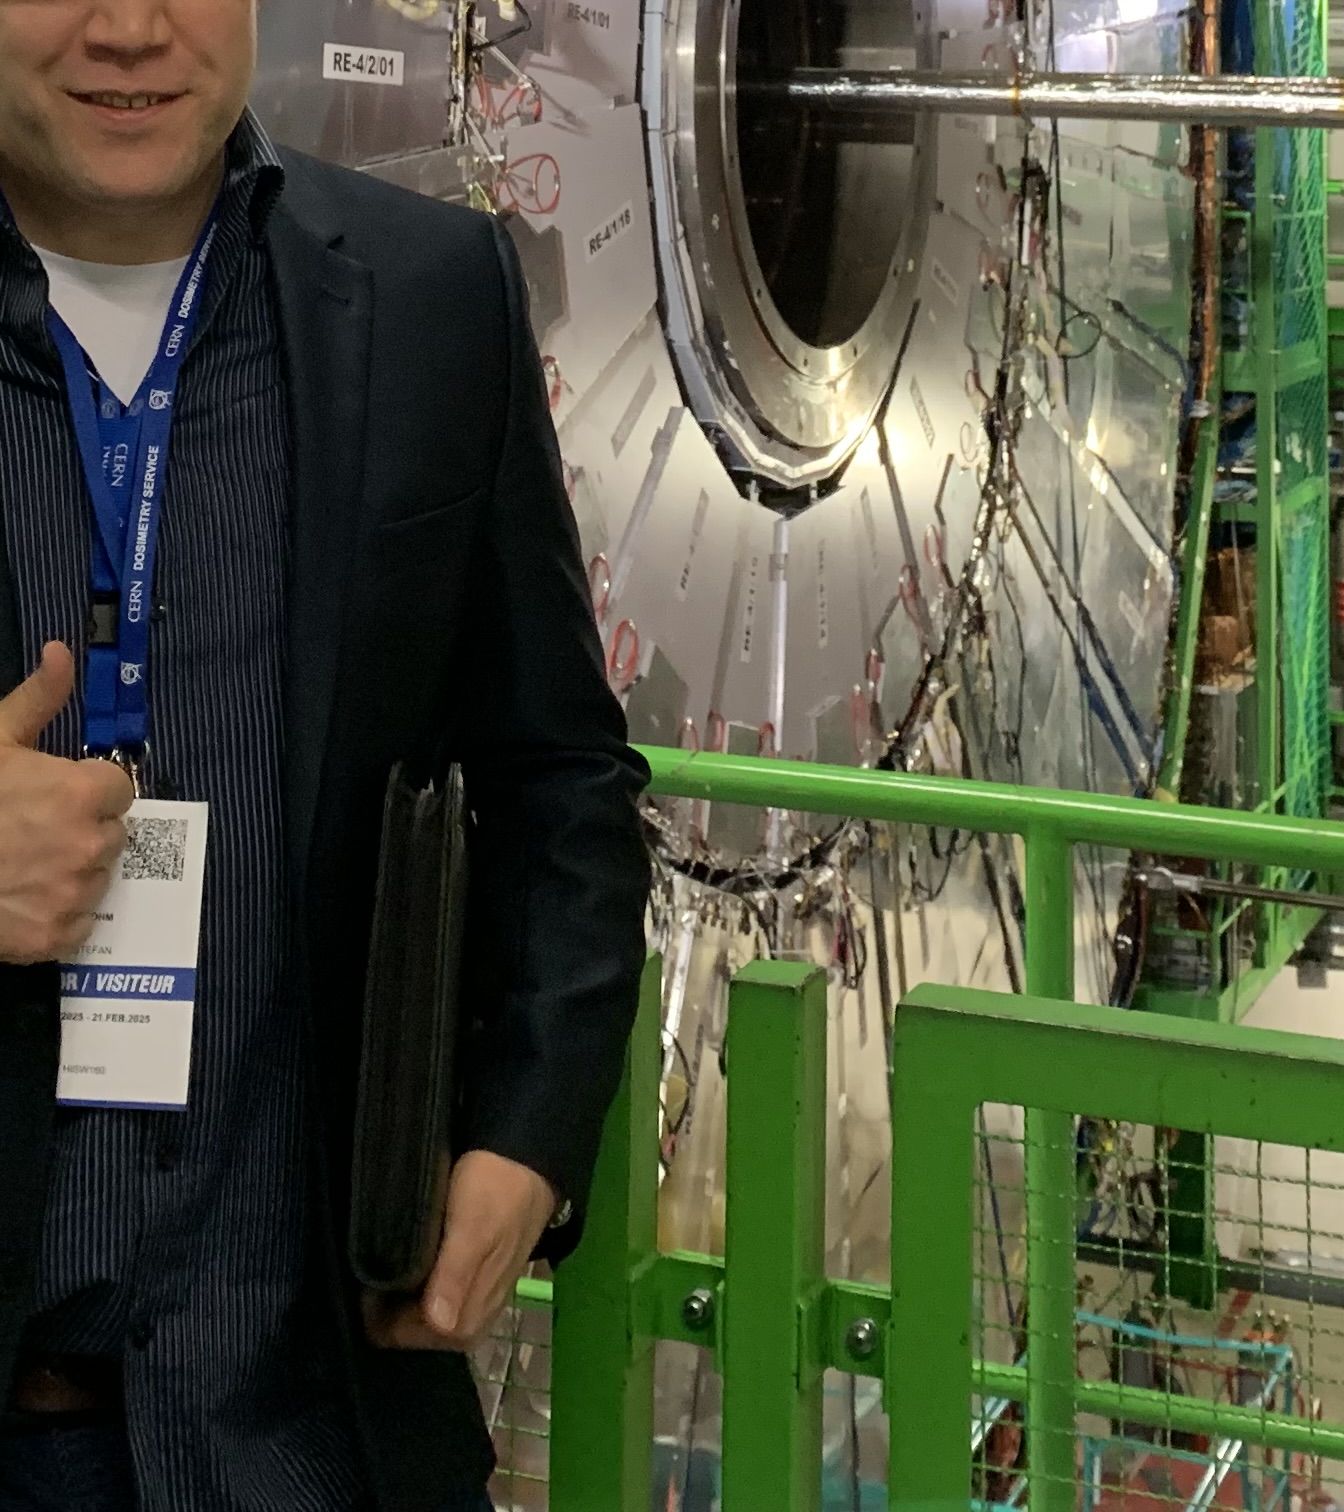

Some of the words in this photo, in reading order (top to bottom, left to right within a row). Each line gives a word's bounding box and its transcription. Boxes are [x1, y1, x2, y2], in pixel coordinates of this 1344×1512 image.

[566, 1, 610, 29] RE-4/1/01
[333, 52, 394, 77] RE-4/2/01
[588, 208, 631, 256] RE-4/1/18
[164, 324, 186, 357] CERN
[177, 261, 204, 319] DOSIMETRY
[111, 443, 129, 487] CERN
[143, 445, 160, 499] SERVICE
[133, 499, 152, 571] DOSIMETRY
[127, 580, 143, 623] CERN
[81, 972, 90, 993] /
[95, 973, 176, 995] VISITEUR
